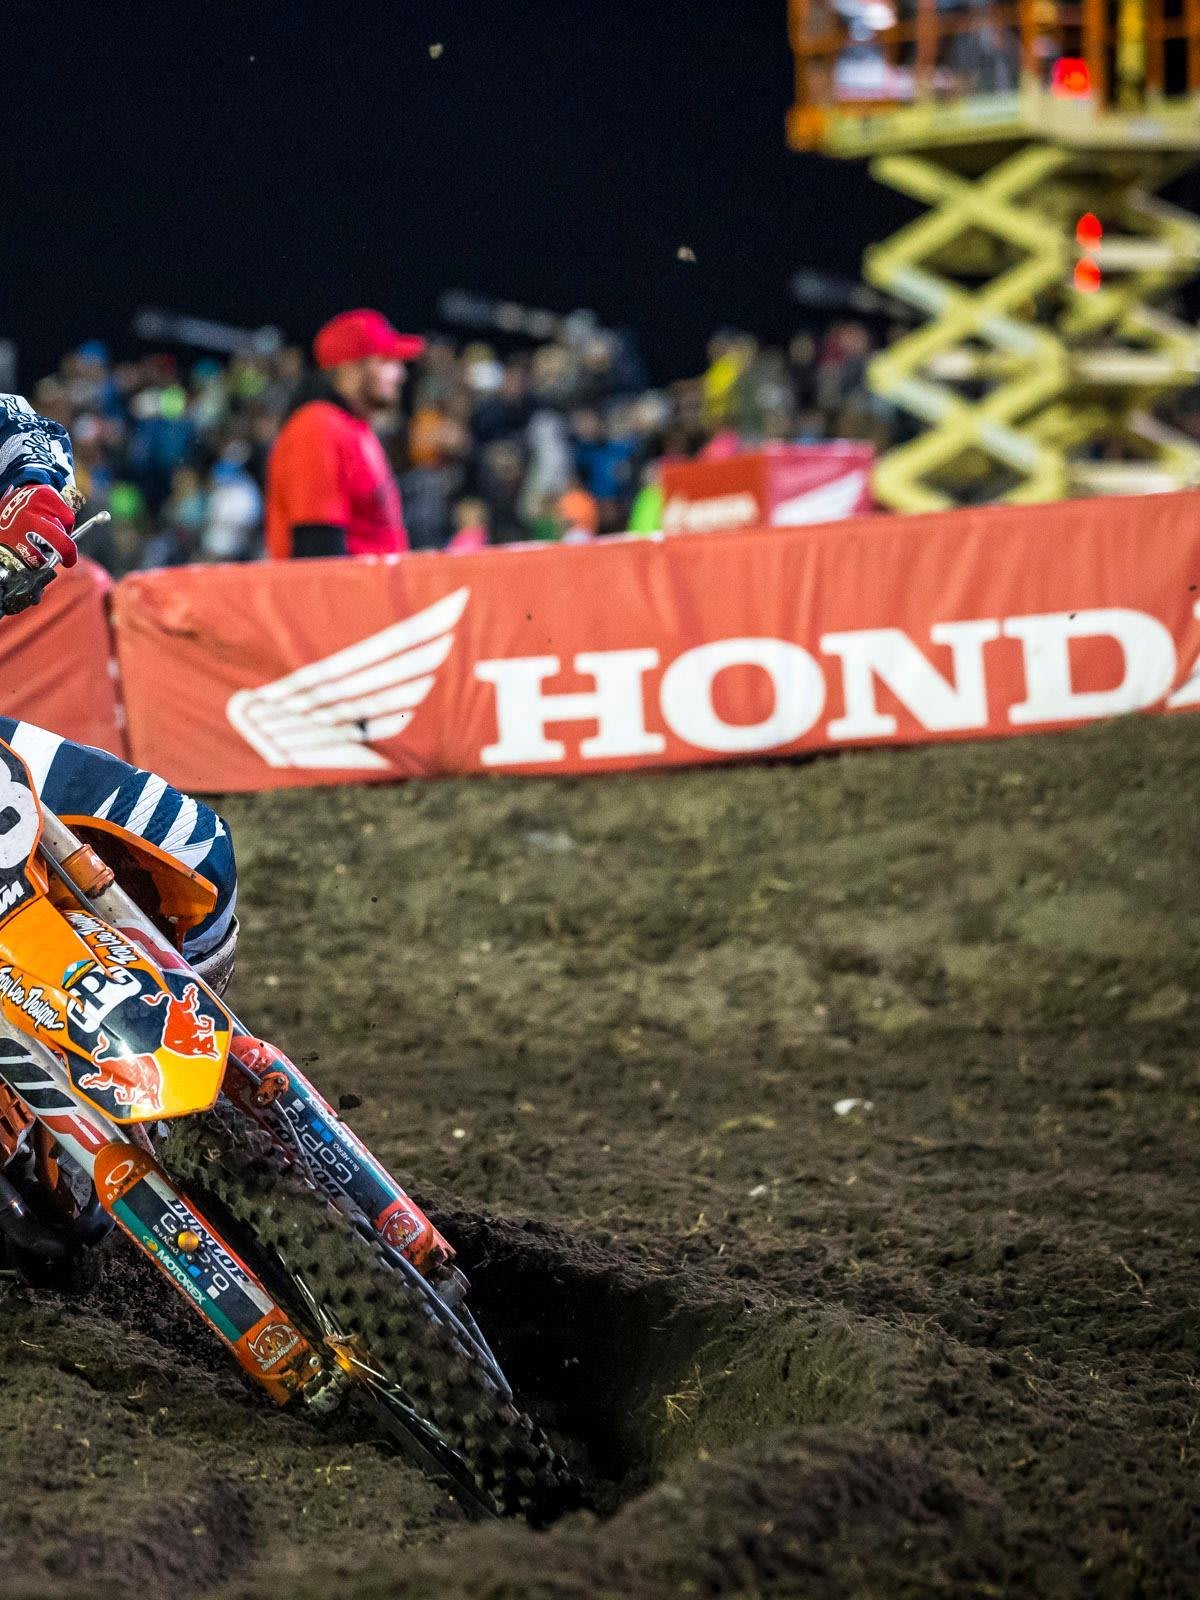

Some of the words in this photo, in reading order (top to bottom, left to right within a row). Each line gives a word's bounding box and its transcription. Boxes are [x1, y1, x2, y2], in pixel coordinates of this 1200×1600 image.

[7, 975, 25, 1005] Lee
[22, 987, 64, 1029] Designs
[156, 1249, 207, 1304] MOTOREX
